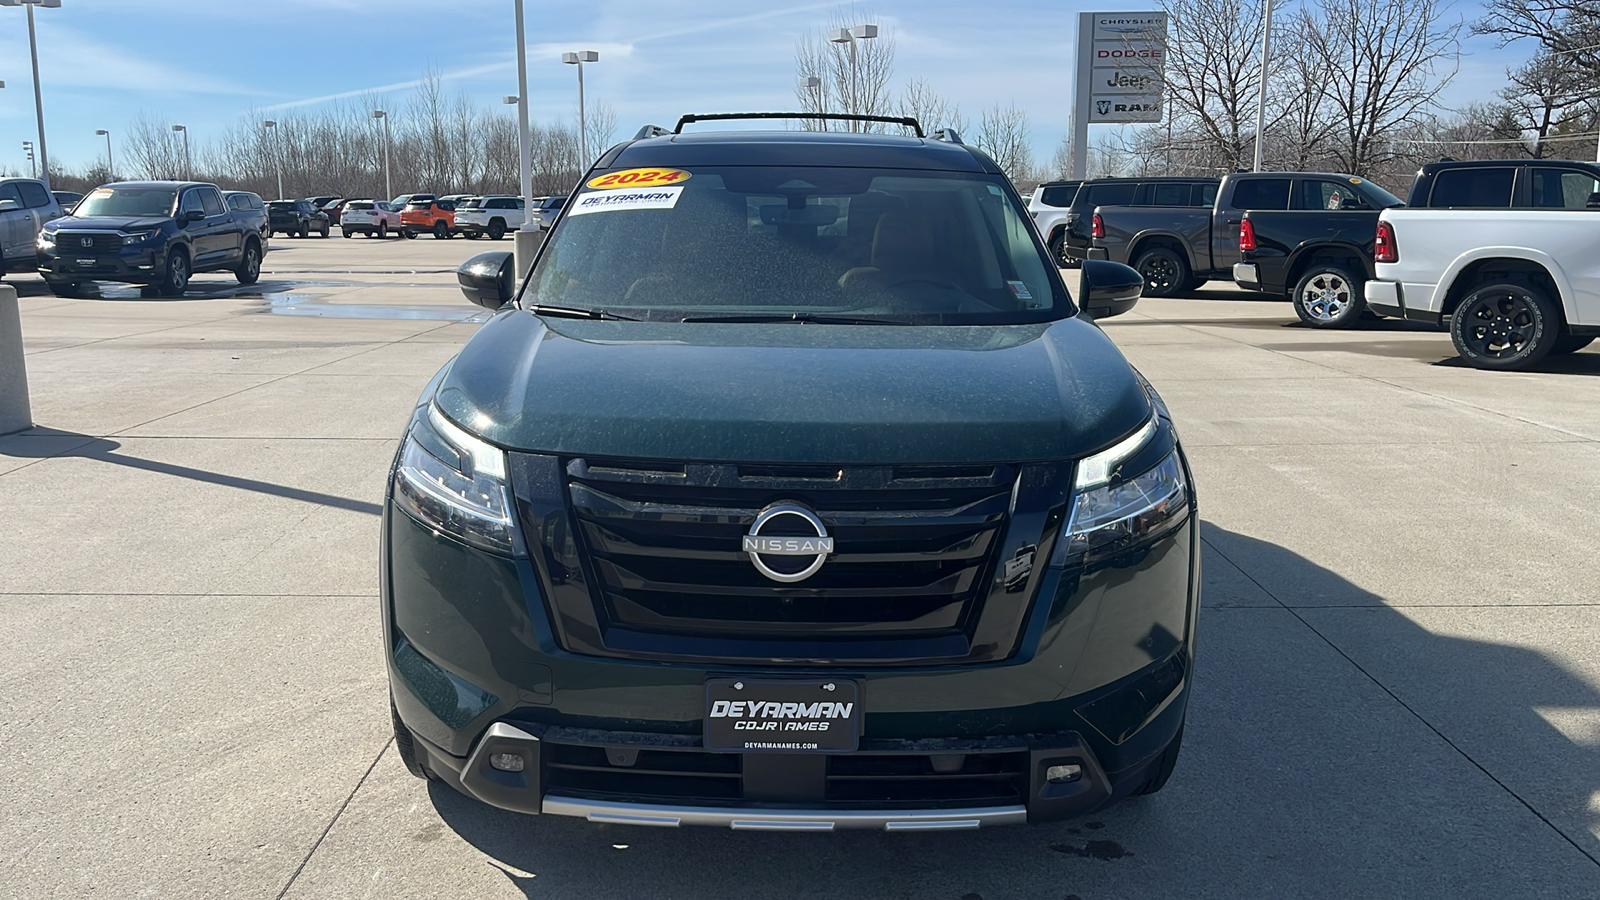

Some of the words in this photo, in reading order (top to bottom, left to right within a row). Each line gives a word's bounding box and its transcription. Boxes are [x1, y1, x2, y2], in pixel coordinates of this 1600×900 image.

[1097, 49, 1162, 58] DODGE
[1107, 72, 1151, 89] Jeep
[1114, 104, 1160, 112] RAM
[596, 171, 683, 187] 2024
[581, 193, 675, 205] DEYARMAN
[745, 538, 831, 551] NISSAN
[710, 700, 853, 719] DEYARMAN
